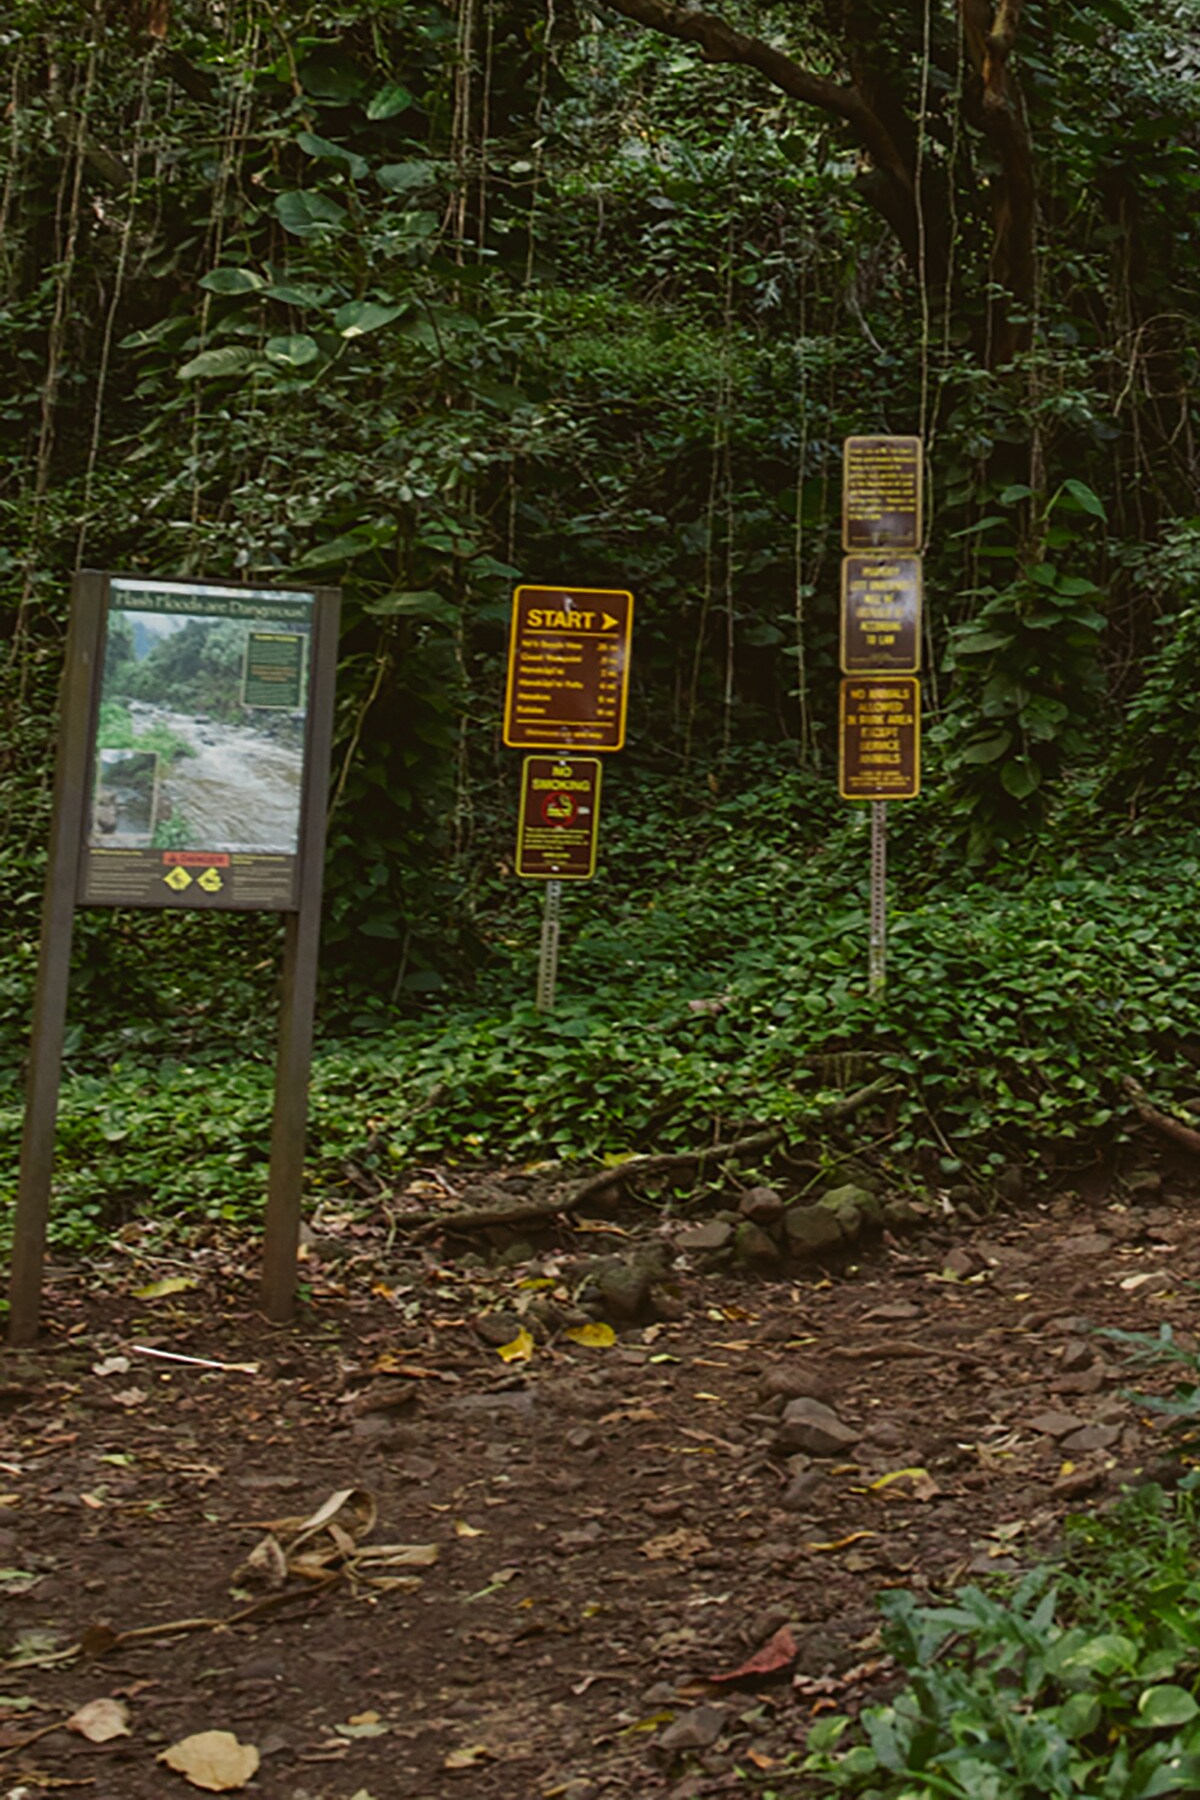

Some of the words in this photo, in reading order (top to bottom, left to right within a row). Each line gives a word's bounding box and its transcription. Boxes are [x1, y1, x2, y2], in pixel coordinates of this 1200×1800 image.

[527, 609, 596, 629] START
[851, 689, 866, 700] NO
[869, 688, 909, 699] ANIMALS
[858, 701, 904, 713] ALLOWED
[888, 714, 913, 725] AREA
[552, 766, 573, 778] NO
[532, 778, 591, 792] SMOKING
